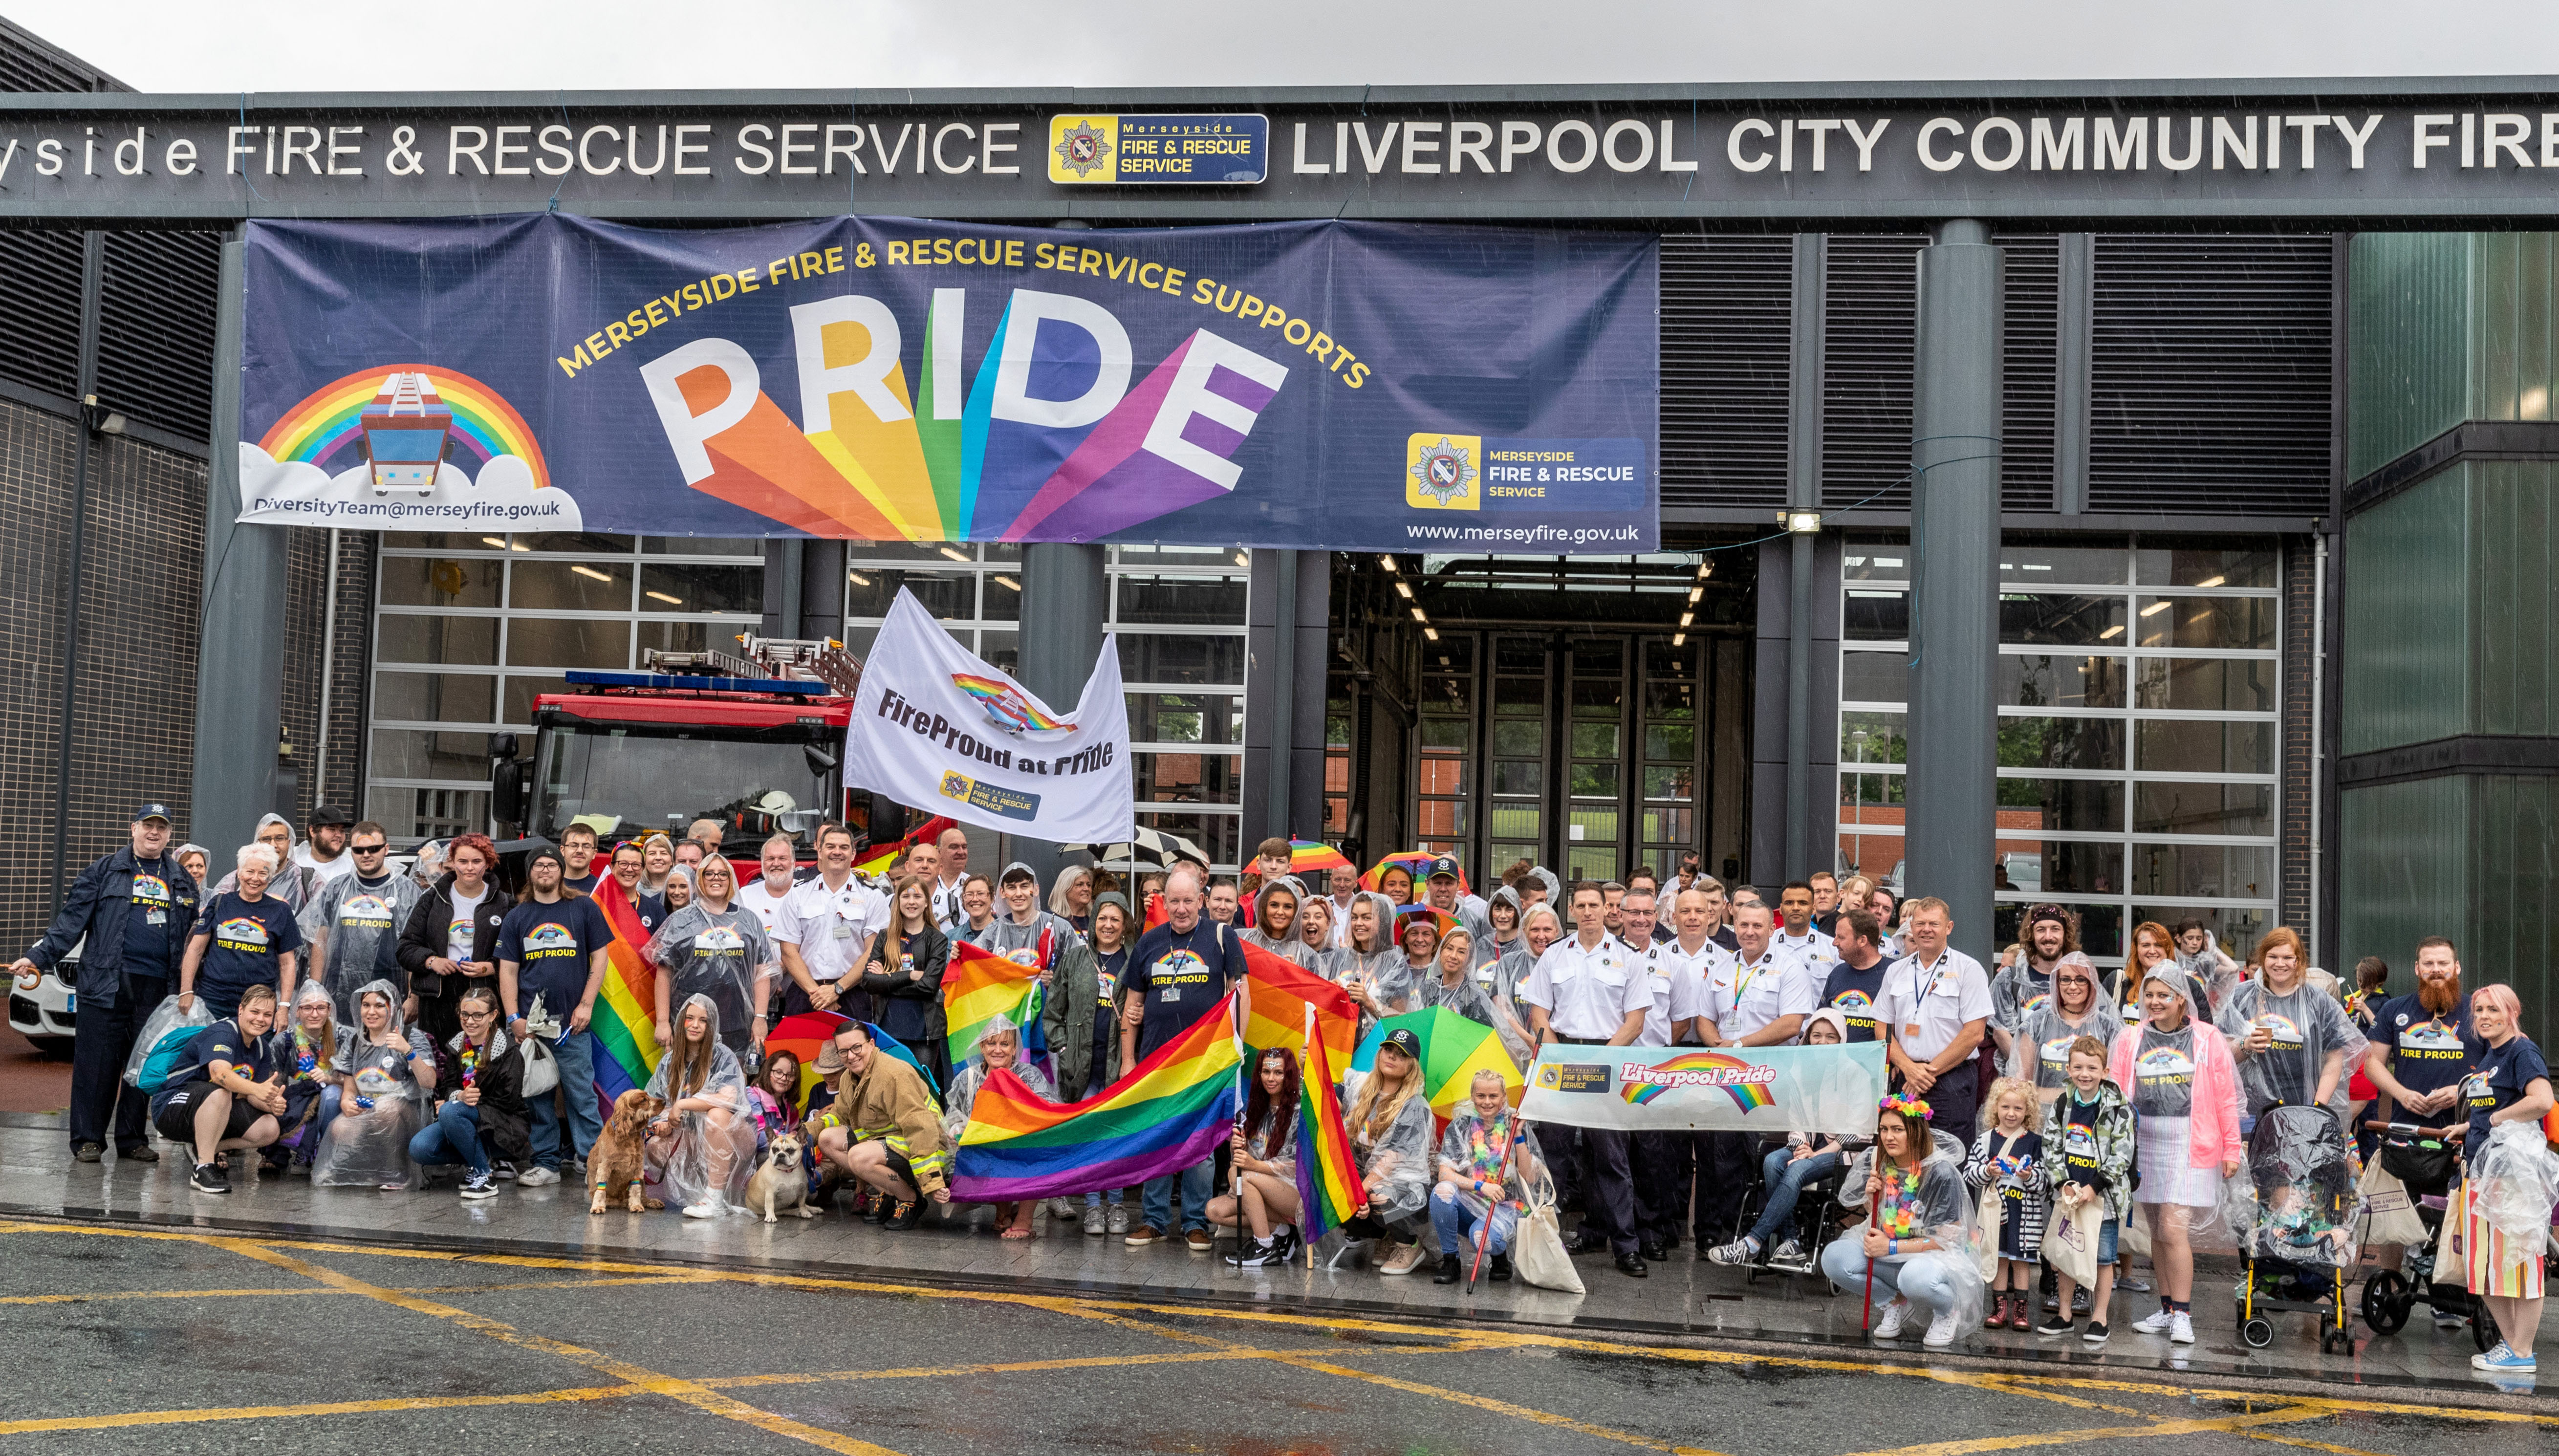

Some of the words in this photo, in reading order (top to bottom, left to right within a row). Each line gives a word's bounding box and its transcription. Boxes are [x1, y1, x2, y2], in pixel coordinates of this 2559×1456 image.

[1123, 124, 1232, 134] Merseyside
[227, 125, 363, 176] FIRE
[386, 125, 425, 176] &
[448, 124, 711, 176] RESCUE
[735, 122, 1020, 175] SERVICE
[1122, 140, 1158, 154] FIRE
[1164, 140, 1177, 154] &
[1183, 140, 1251, 154] RESCUE
[1293, 119, 1698, 174] LIVERPOOL
[1726, 118, 1891, 173] CITY
[1916, 115, 2384, 172] COMMUNITY
[1121, 159, 1193, 172] SERVICE
[557, 267, 760, 378] MERSEYSIDE
[768, 246, 845, 285] FIRE
[854, 242, 876, 268] &
[888, 239, 1024, 265] RESCUE
[1035, 243, 1187, 296] SERVICE
[1192, 278, 1371, 389] SUPPORTS
[639, 287, 1289, 491] PRIDE
[1489, 451, 1574, 462] MERSEYSIDE
[1489, 466, 1532, 481] FIRE
[1537, 466, 1550, 481] &
[1556, 466, 1633, 481] RESCUE
[1489, 487, 1545, 497] SERVICE
[254, 498, 560, 519] DiversityTeam@merseyfire.gov.uk
[1407, 524, 1639, 544] www.merseyfire.gov.uk
[878, 688, 1012, 769] FireProud
[1018, 758, 1048, 775] at
[1054, 740, 1113, 775] Pride
[975, 783, 1025, 800] Merseyside
[971, 797, 1003, 811] SERVICE
[973, 790, 991, 800] FIRE
[999, 798, 1032, 810] RESCUE
[360, 920, 391, 928] PROUD
[217, 939, 233, 949] FIRE
[235, 942, 266, 953] PROUD
[545, 949, 576, 957] PROUD
[1152, 977, 1172, 985] FIRE
[1175, 975, 1208, 983] PROUD
[2401, 1049, 2421, 1058] FIRE
[2425, 1051, 2464, 1059] PROUD
[1620, 1063, 1721, 1088] Liverpool
[1718, 1065, 1777, 1086] Pride
[2470, 1097, 2496, 1107] PROUD
[2068, 1155, 2096, 1168] PROU
